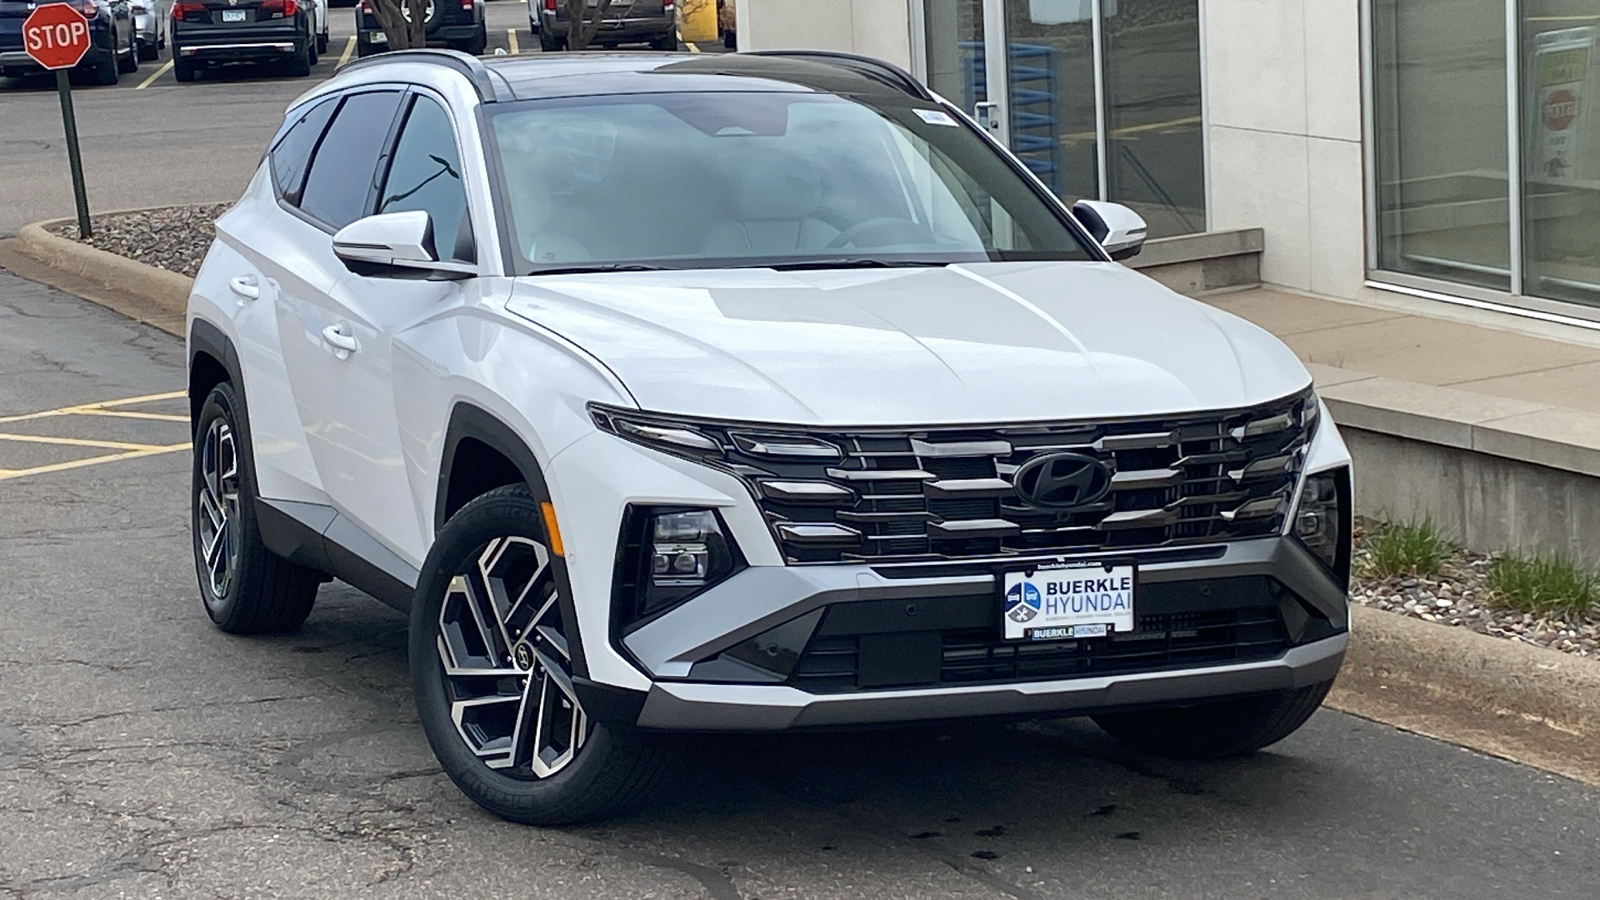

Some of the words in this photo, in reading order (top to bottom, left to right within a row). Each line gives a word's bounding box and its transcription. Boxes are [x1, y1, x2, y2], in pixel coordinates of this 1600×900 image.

[28, 22, 85, 50] STOP
[1046, 577, 1131, 596] BUERKLE
[1045, 592, 1131, 615] HYUNDAI
[1034, 626, 1074, 638] BUERKLE
[1075, 624, 1105, 635] HYUNDAI
